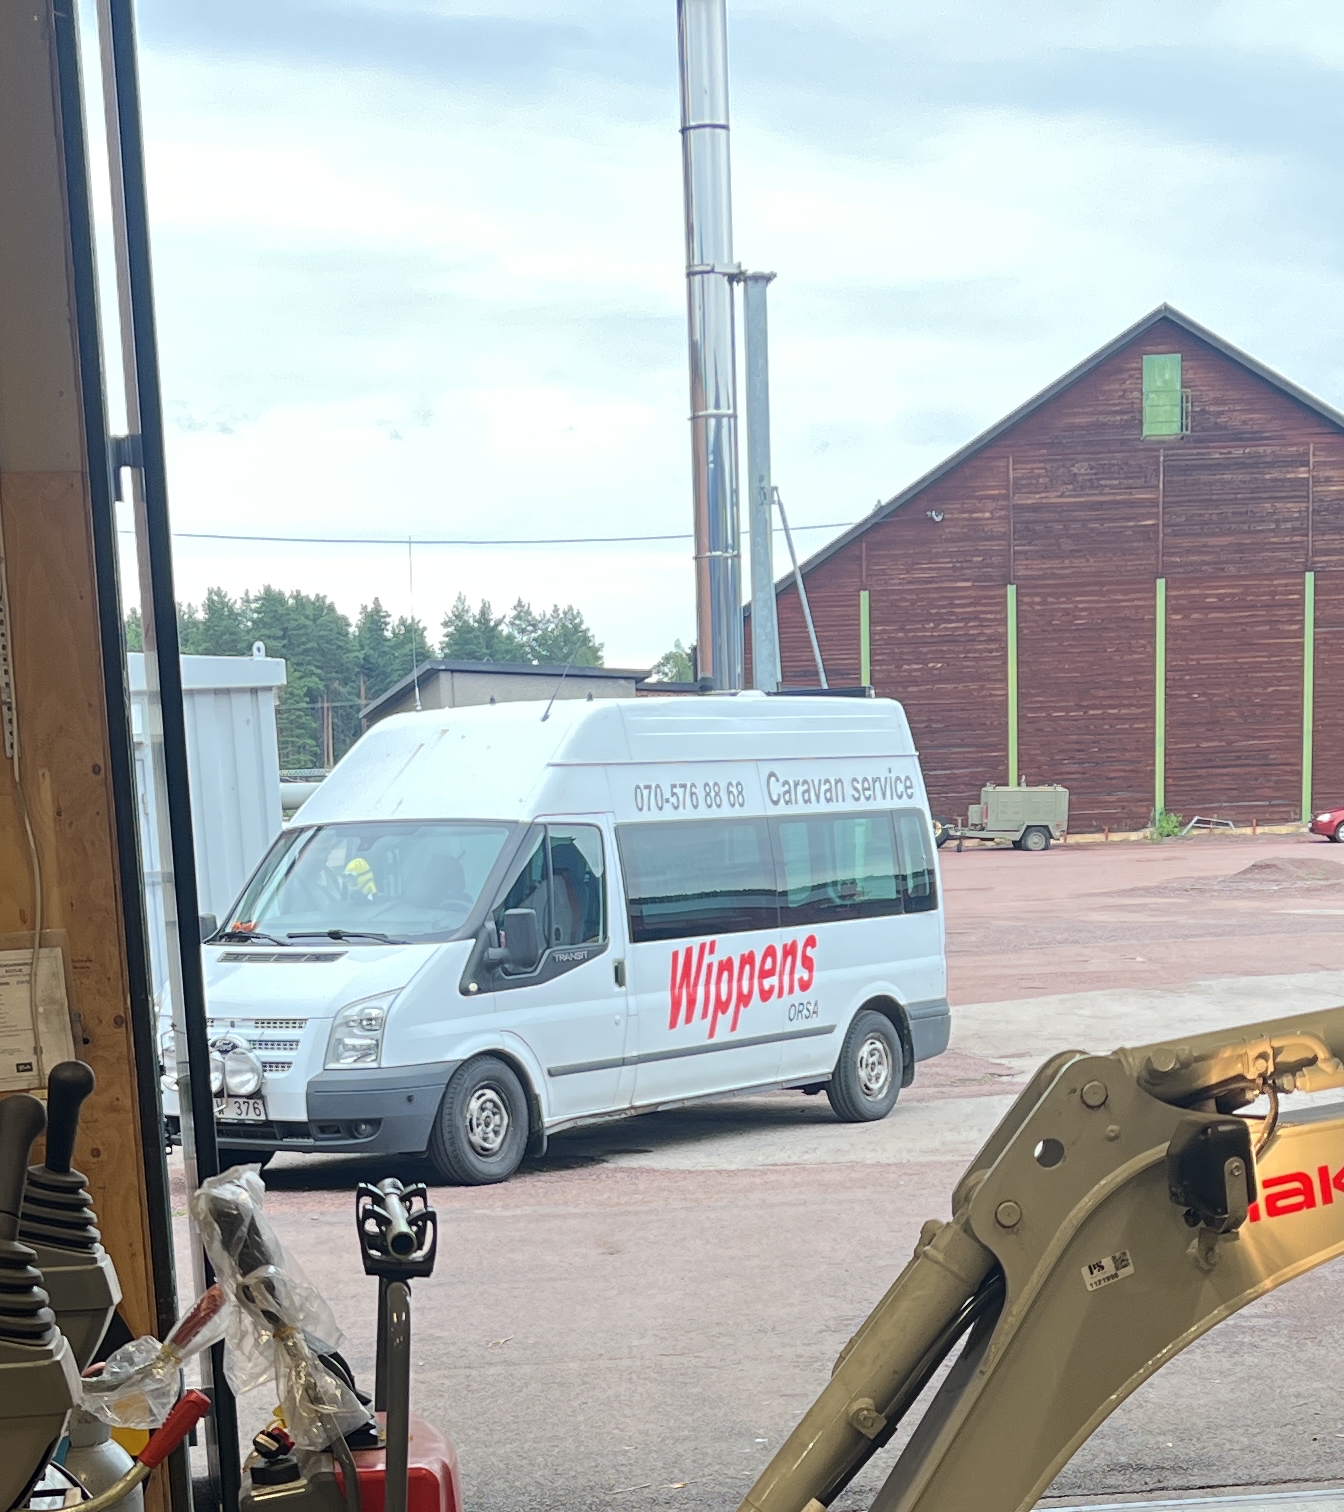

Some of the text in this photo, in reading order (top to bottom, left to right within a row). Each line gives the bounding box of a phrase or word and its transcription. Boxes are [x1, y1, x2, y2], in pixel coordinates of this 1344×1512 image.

[634, 780, 746, 812] 070-576 88 68
[766, 767, 915, 807] Caravan service
[553, 950, 588, 962] TRANSIT
[668, 934, 817, 1040] Wippens
[788, 1000, 819, 1022] ORSA
[233, 1100, 262, 1117] 376
